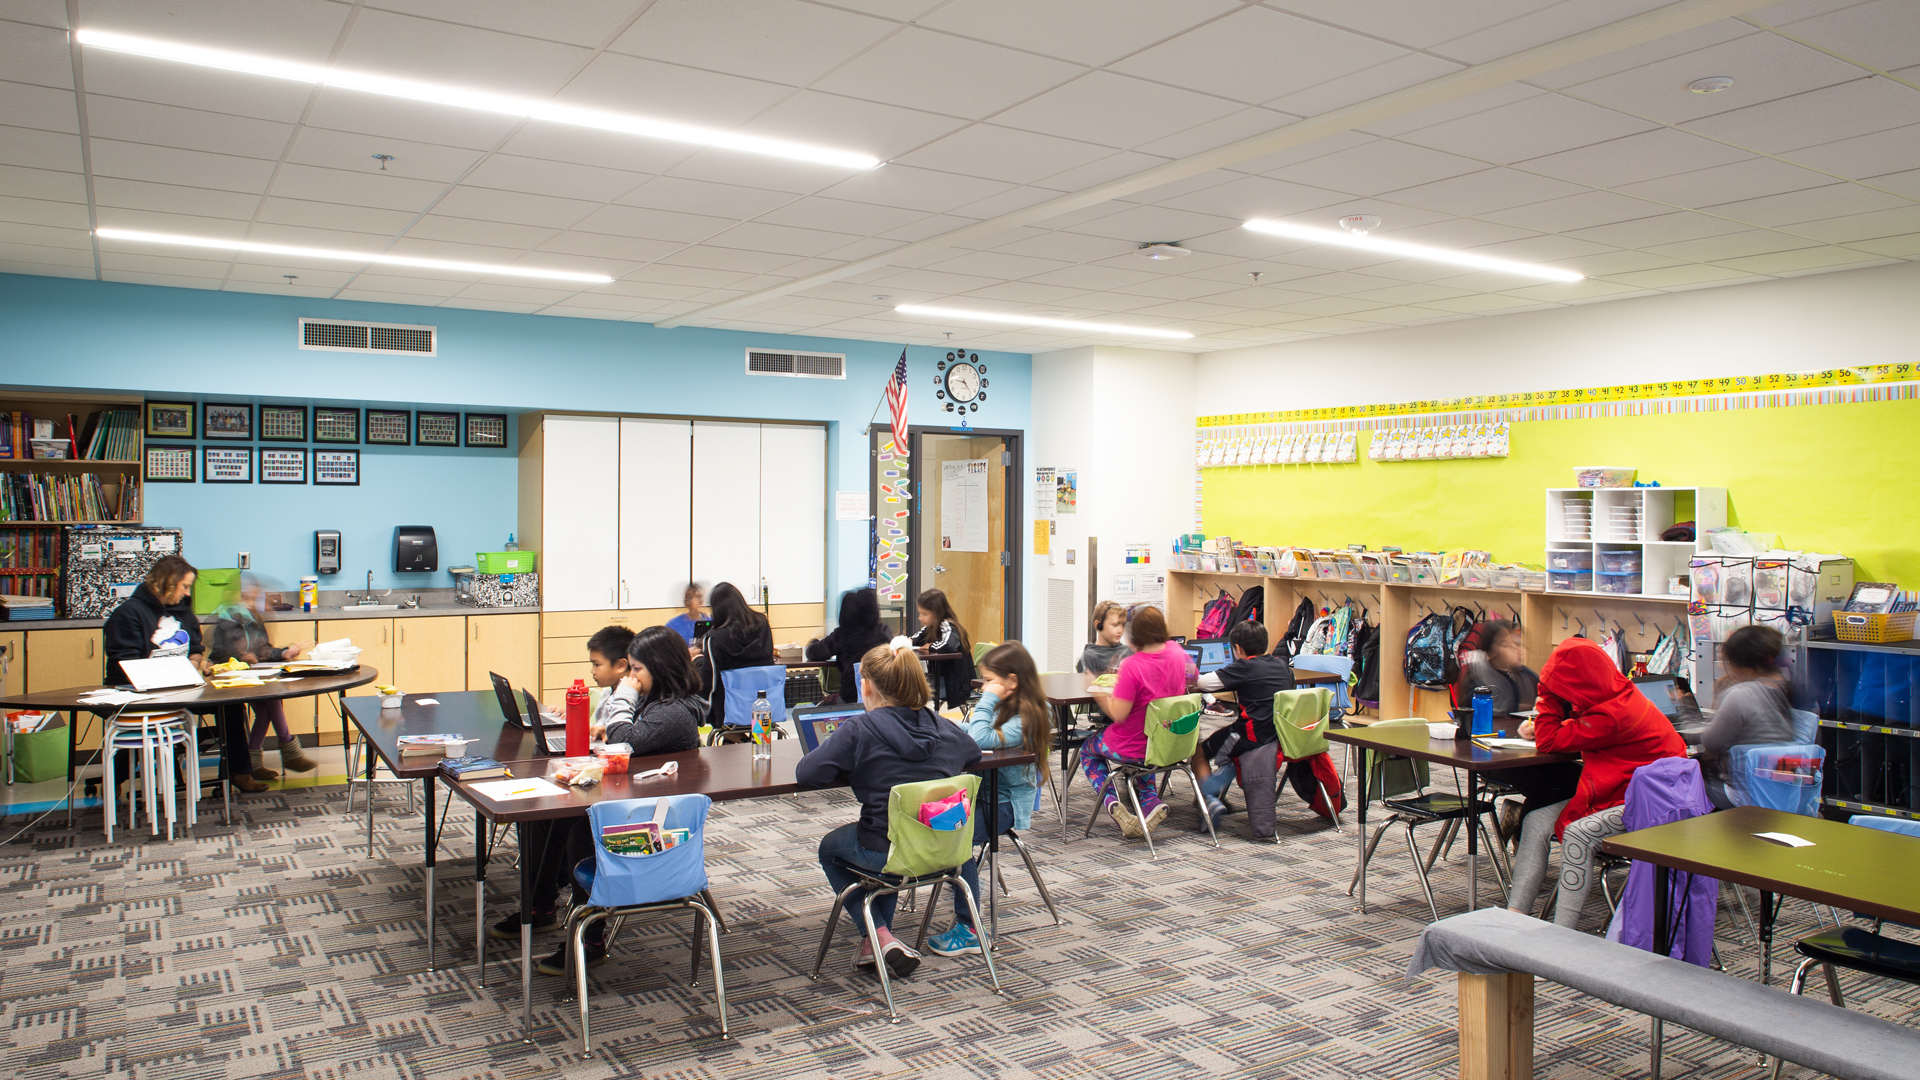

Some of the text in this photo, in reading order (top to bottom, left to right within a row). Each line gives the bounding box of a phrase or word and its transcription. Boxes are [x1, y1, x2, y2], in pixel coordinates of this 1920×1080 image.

[1769, 375, 1779, 383] 52
[1786, 373, 1797, 382] 53
[1803, 372, 1814, 380] 54
[1821, 370, 1833, 379] 55
[1840, 369, 1851, 378] 56
[1858, 367, 1870, 376] 57
[1878, 365, 1889, 375] 58
[1896, 364, 1909, 373] 59
[1561, 810, 1626, 891] adida
